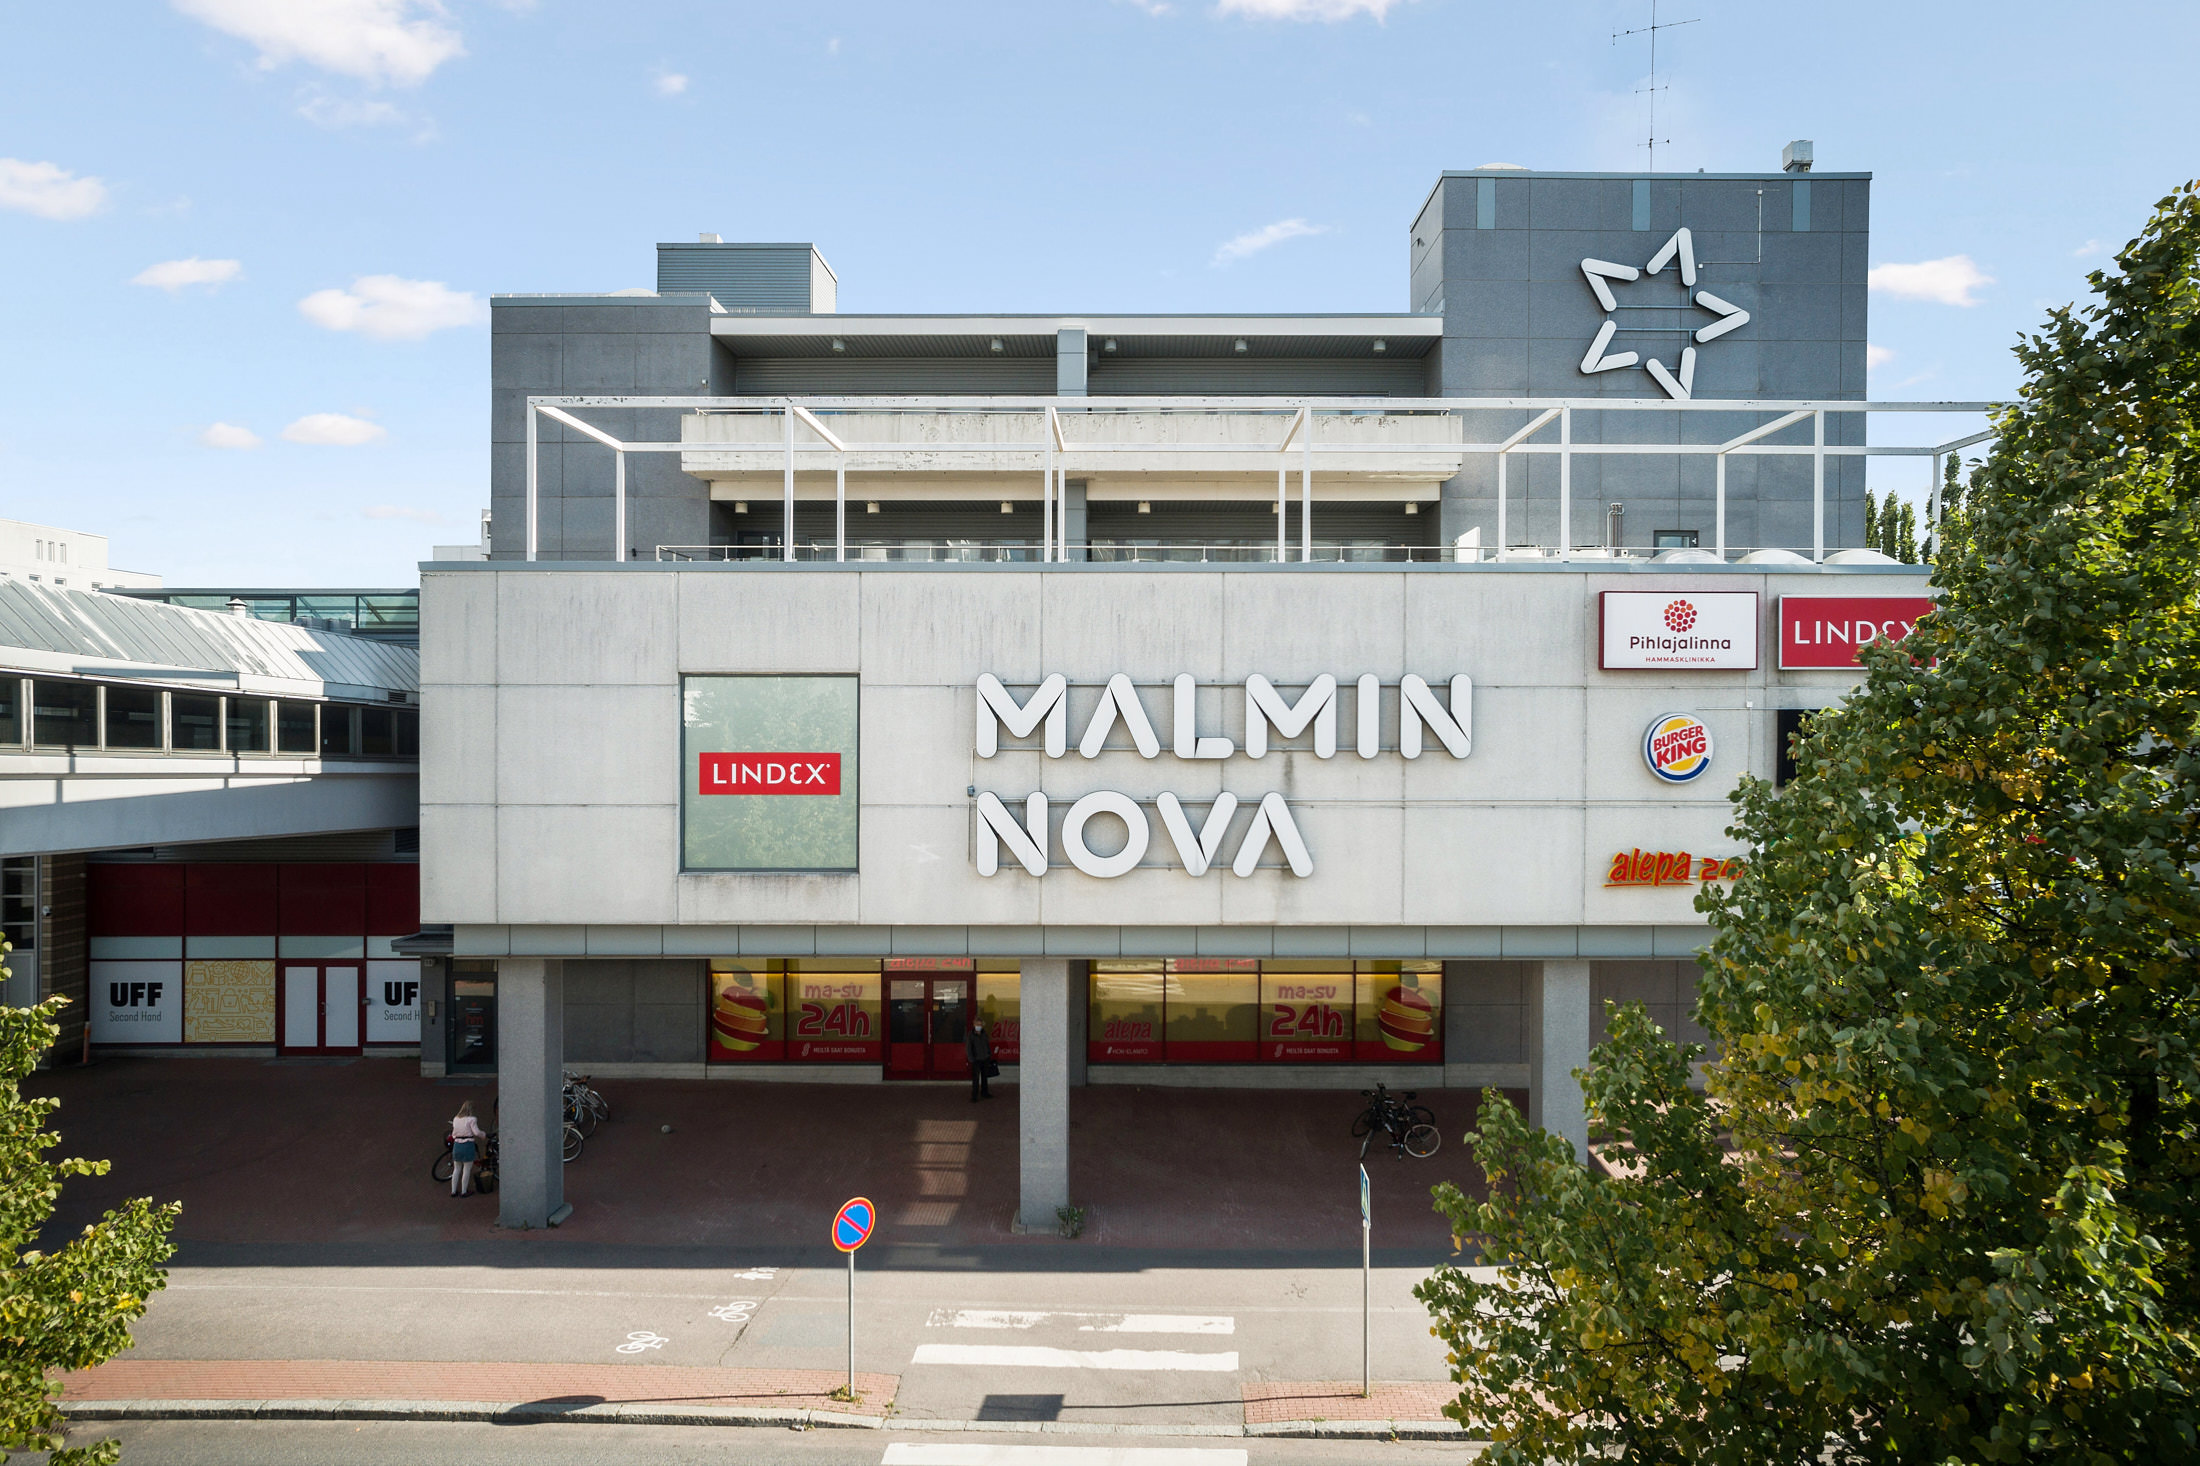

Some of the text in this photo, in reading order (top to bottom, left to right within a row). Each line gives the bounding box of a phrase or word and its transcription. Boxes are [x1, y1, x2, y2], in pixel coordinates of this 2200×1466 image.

[1630, 636, 1731, 653] Pihlajalinna
[975, 672, 1472, 760] MALMIN
[1653, 725, 1704, 752] BURGER
[1656, 736, 1707, 769] KING
[713, 763, 830, 784] LINDEX
[975, 790, 1315, 878] NOVA
[1608, 848, 1744, 886] alepa 24
[110, 982, 163, 1007] UFF
[384, 981, 419, 1006] UF
[804, 983, 863, 1000] ma-su
[1277, 984, 1337, 1000] ma-su
[109, 1010, 162, 1022] Second Hand
[384, 1009, 412, 1021] Second
[796, 1003, 871, 1038] 24h
[1270, 1003, 1344, 1038] 24h
[1103, 1019, 1153, 1041] alepa
